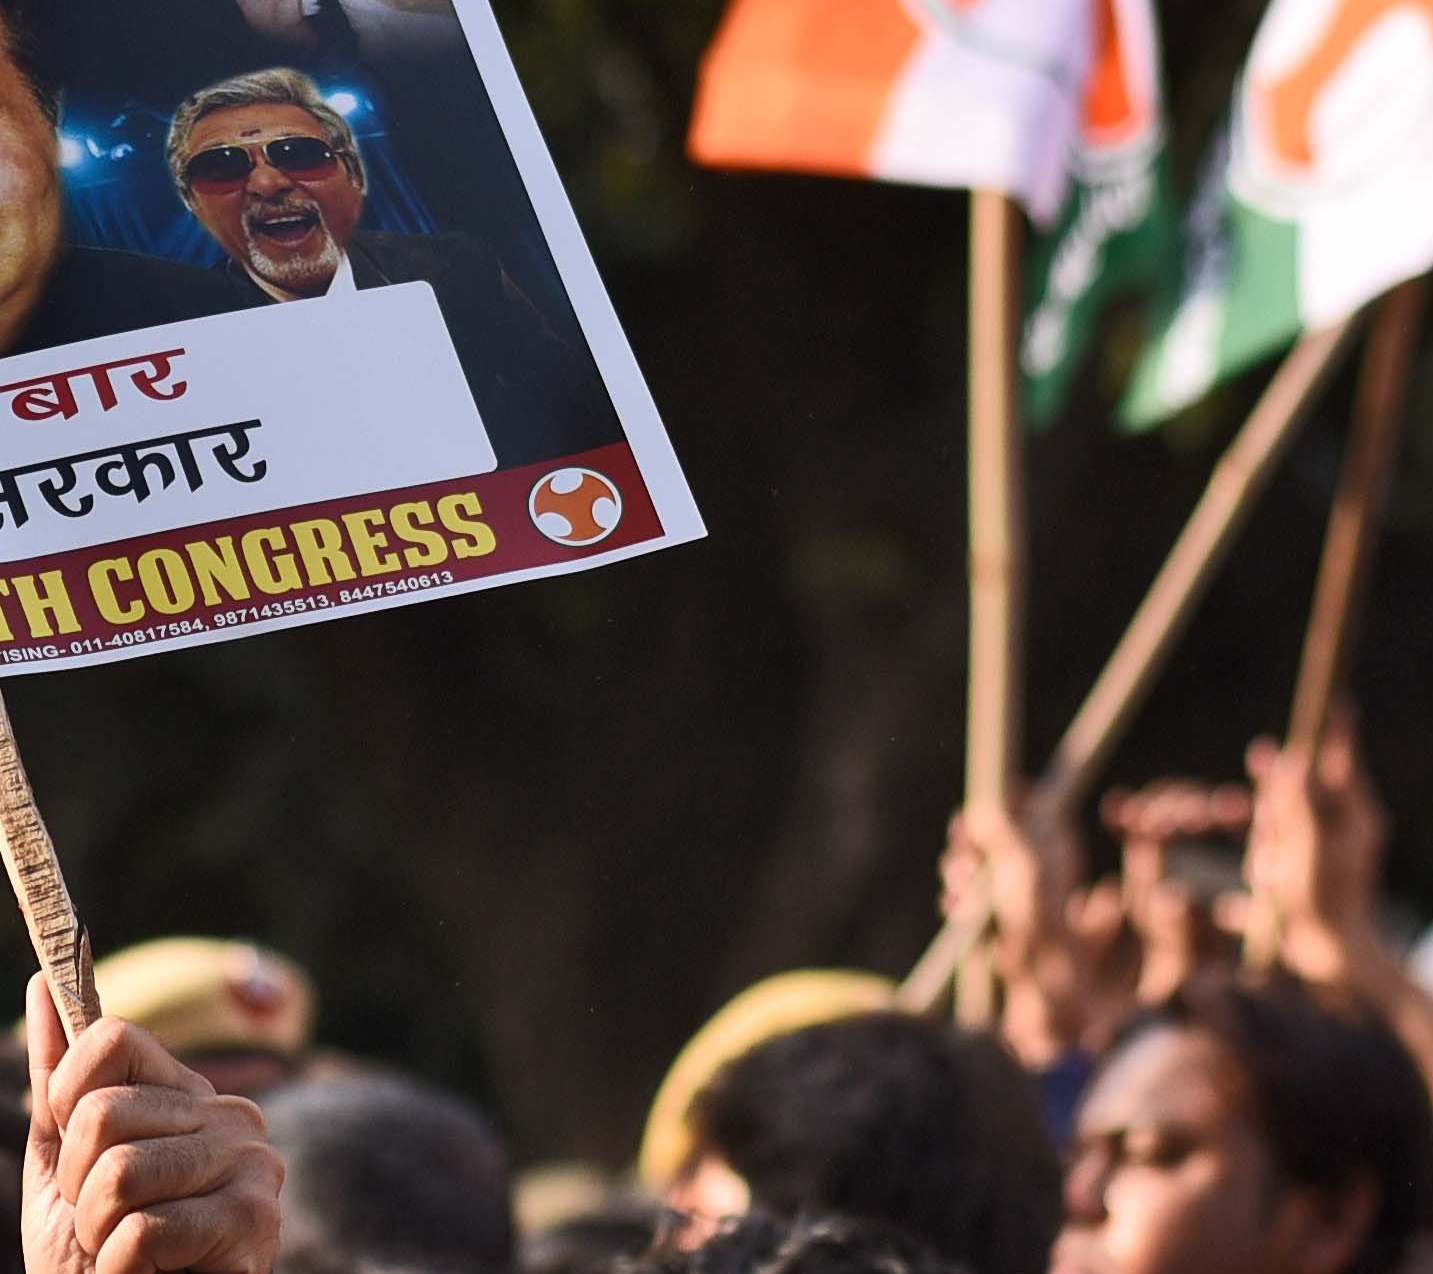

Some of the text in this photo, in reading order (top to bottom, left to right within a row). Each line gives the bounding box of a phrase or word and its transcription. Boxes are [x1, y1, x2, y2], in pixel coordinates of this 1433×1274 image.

[71, 617, 210, 655] 011-40817584,
[214, 593, 336, 628] 9871435513,
[339, 570, 454, 604] 8447540613
[87, 491, 498, 627] CONGRESS
